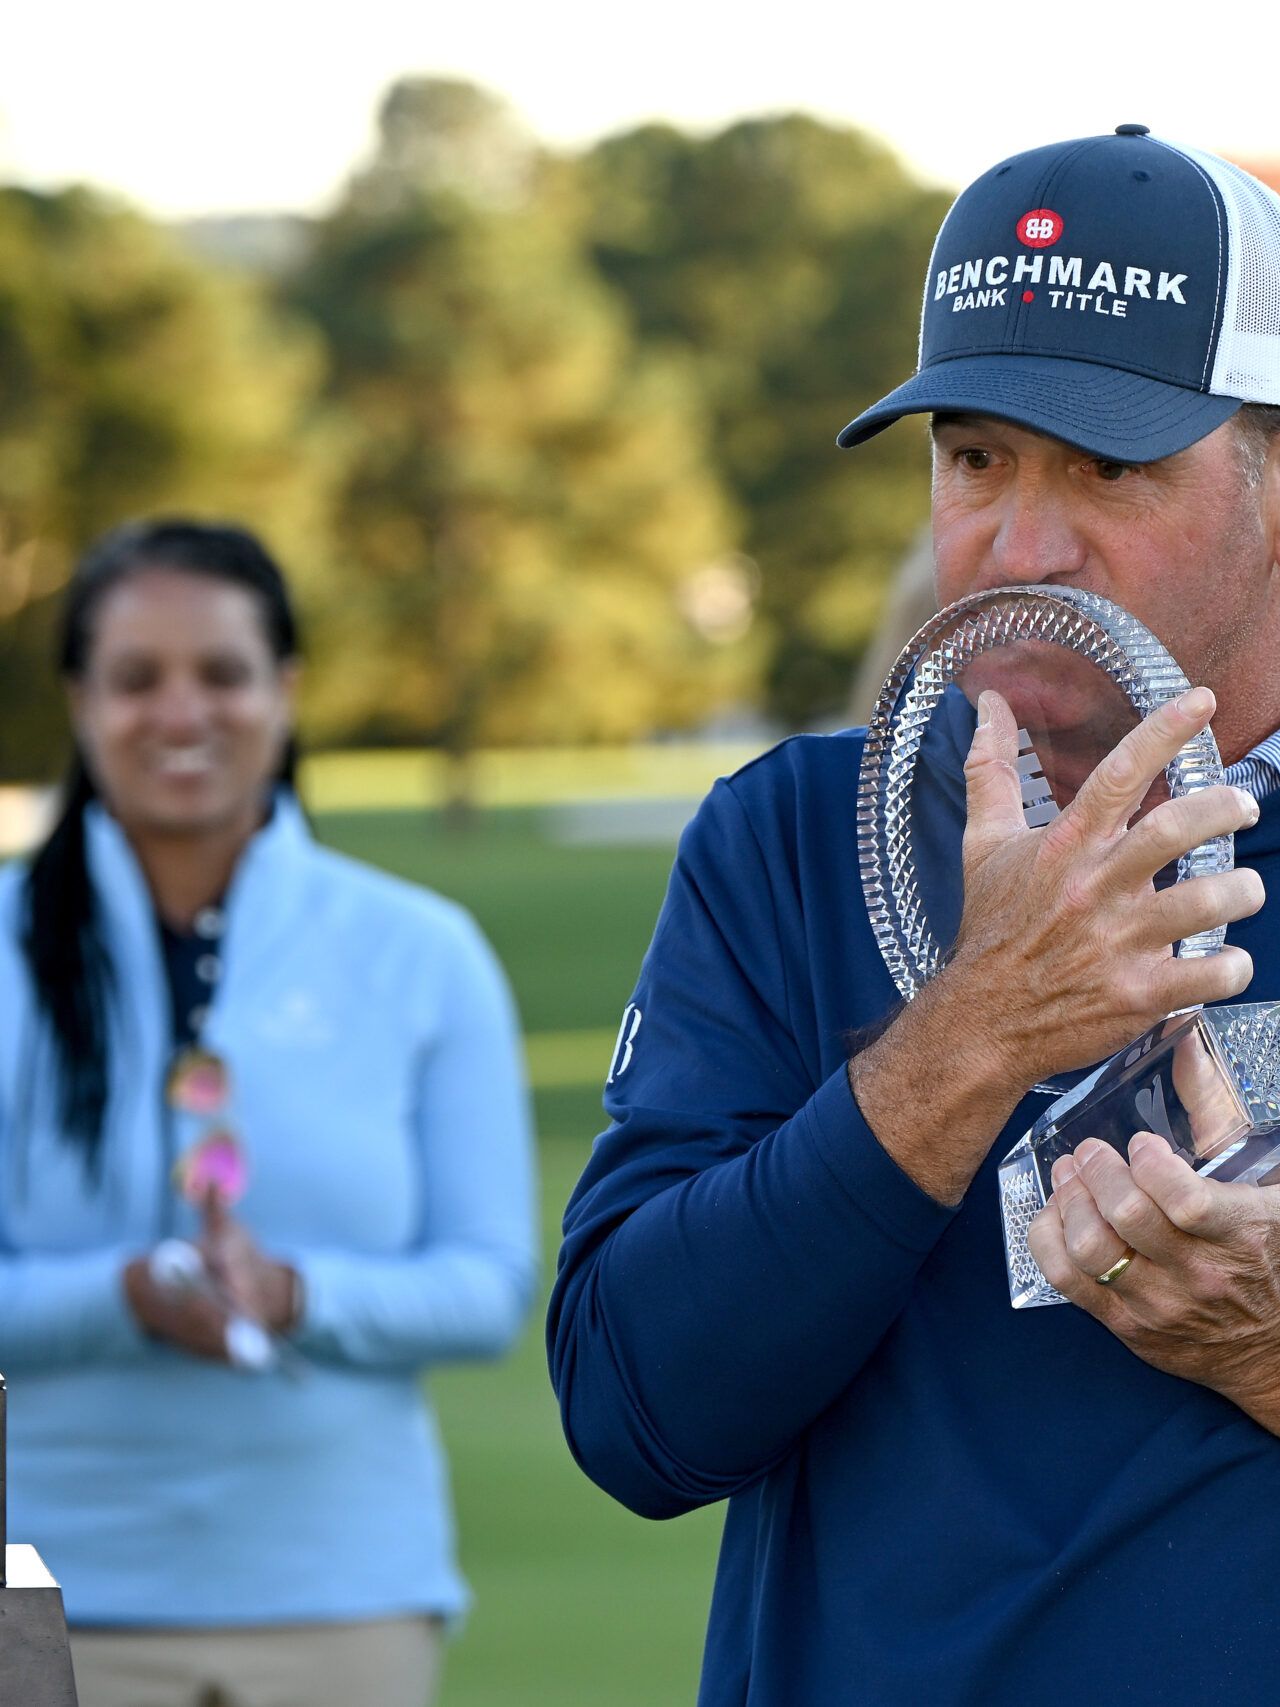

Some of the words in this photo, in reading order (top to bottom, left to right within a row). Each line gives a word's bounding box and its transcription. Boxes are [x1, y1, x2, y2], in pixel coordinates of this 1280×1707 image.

[934, 255, 1189, 305] BENCHMARK
[952, 288, 1008, 312] BANK
[1048, 290, 1128, 318] TITLE
